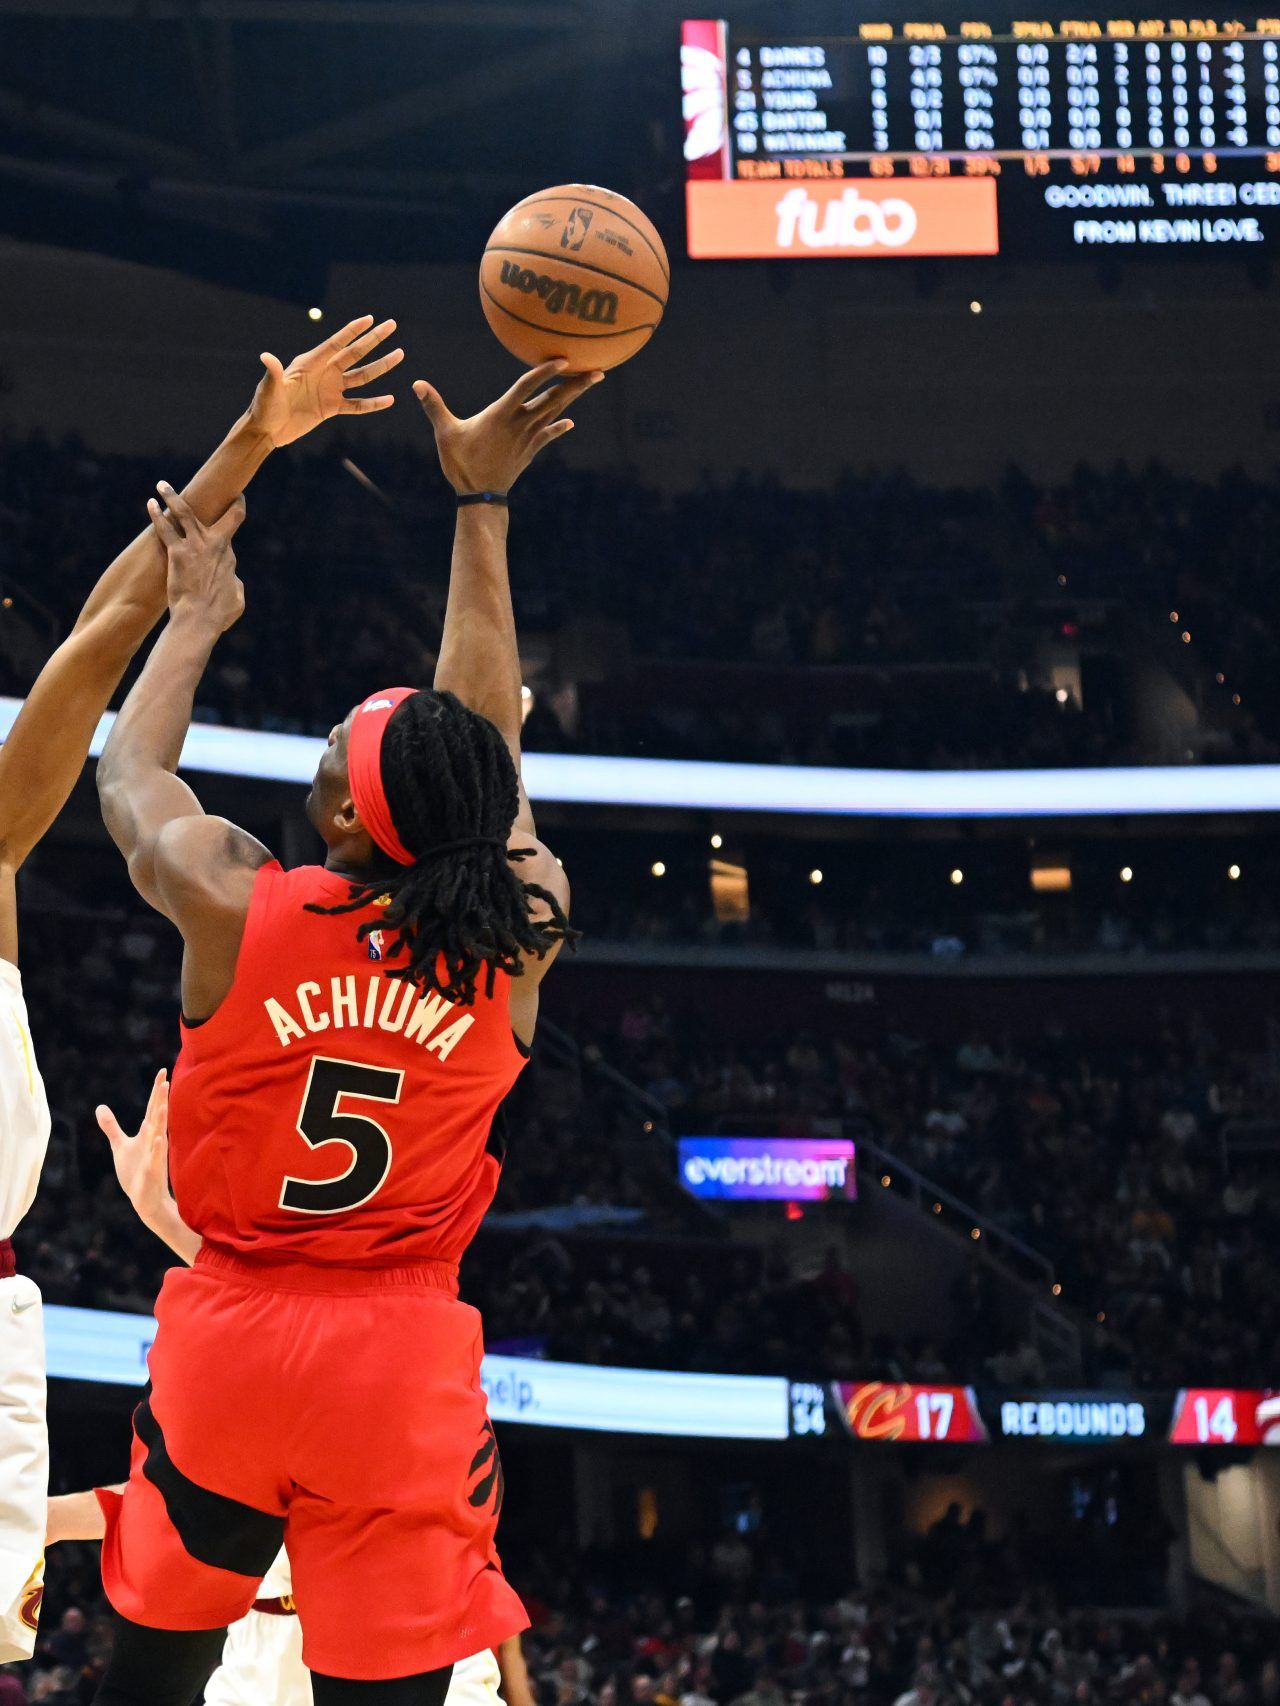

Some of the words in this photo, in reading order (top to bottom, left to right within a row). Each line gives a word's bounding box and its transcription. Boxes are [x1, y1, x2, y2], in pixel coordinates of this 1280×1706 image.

[775, 188, 917, 246] fubo
[1073, 220, 1136, 243] FROM
[1138, 219, 1200, 243] KEVIN
[263, 974, 476, 1063] ACHIUWA
[277, 1054, 406, 1215] 5
[684, 1154, 848, 1188] everstream
[915, 1393, 954, 1440] 17
[1001, 1402, 1145, 1437] REBOUNDS
[1194, 1396, 1237, 1443] 14
